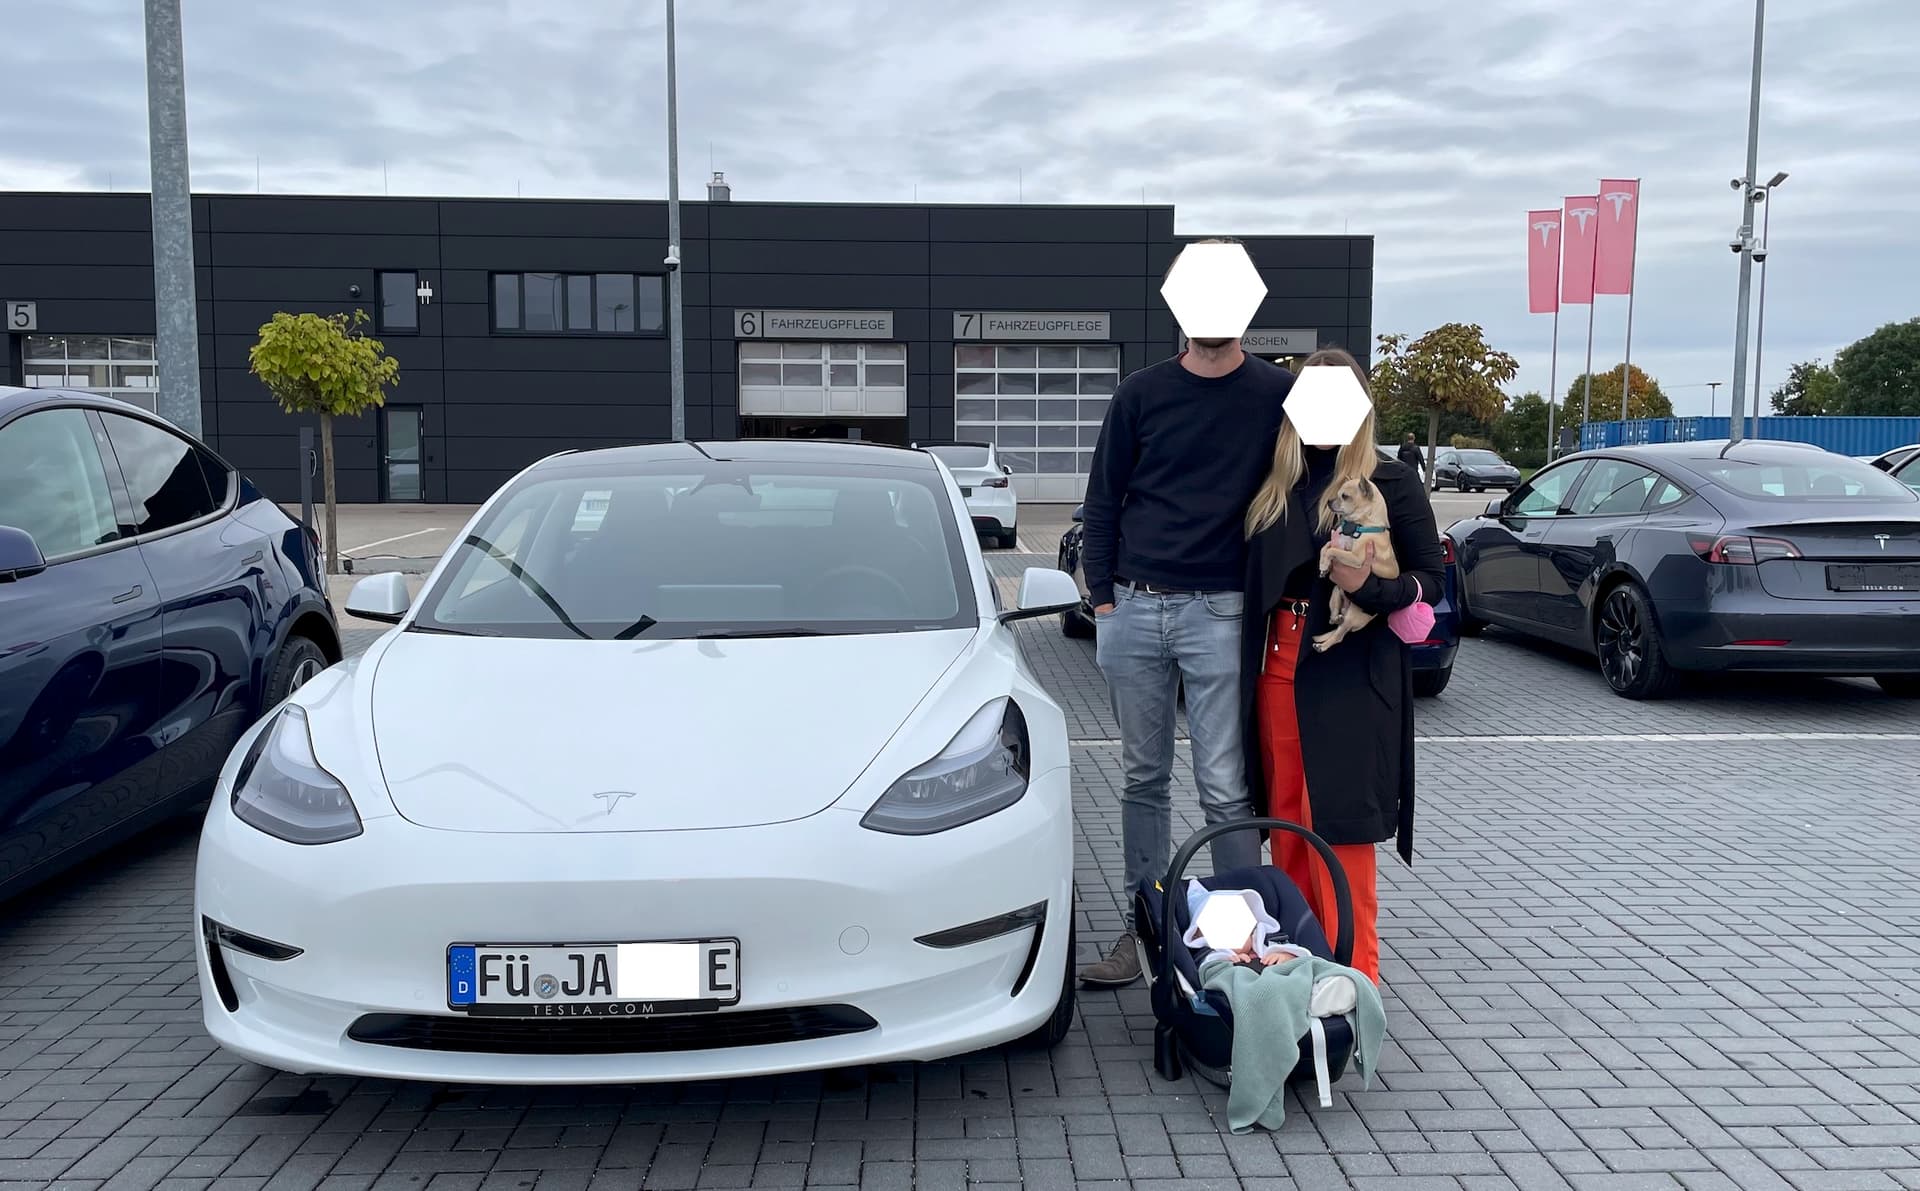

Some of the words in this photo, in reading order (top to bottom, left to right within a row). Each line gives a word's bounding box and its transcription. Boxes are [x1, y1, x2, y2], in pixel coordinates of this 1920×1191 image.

[14, 304, 30, 328] 5
[740, 312, 756, 335] 6
[771, 318, 886, 330] FAHRZEUGPFLEGE
[959, 314, 974, 337] 7
[989, 320, 1103, 331] FAHRZEUGPFLEGE
[1241, 336, 1289, 346] ASCHEN
[479, 954, 530, 997] FÜ
[561, 953, 613, 996] JA
[708, 948, 733, 991] E
[458, 981, 469, 994] D
[533, 1003, 656, 1016] TESLA.COM
